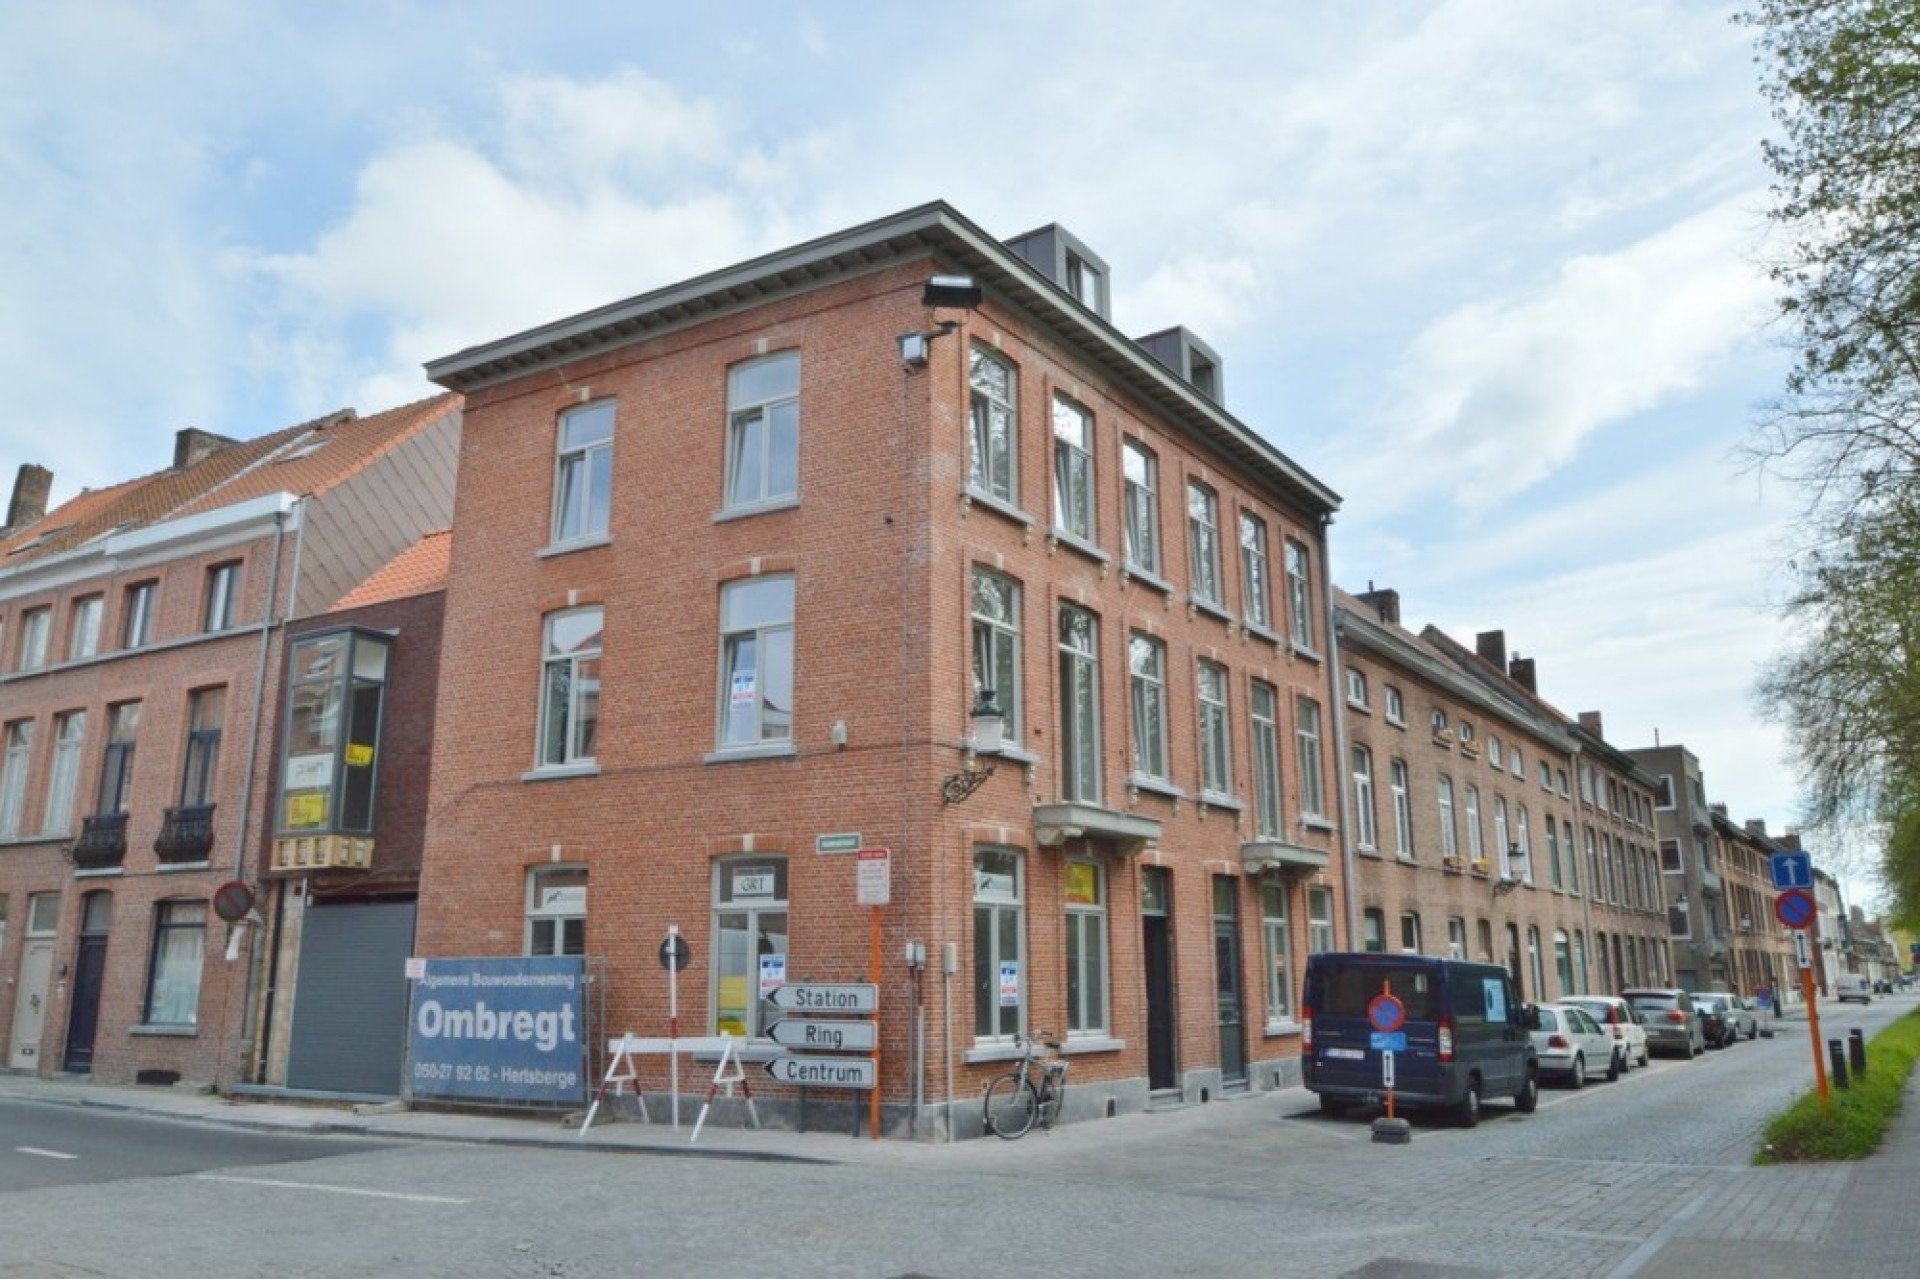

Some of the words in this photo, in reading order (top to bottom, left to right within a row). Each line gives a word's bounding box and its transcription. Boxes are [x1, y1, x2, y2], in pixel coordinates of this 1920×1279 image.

[795, 988, 858, 1007] Station
[417, 999, 575, 1052] Ombregt
[805, 1025, 843, 1049] Ring
[786, 1061, 863, 1082] Centrum
